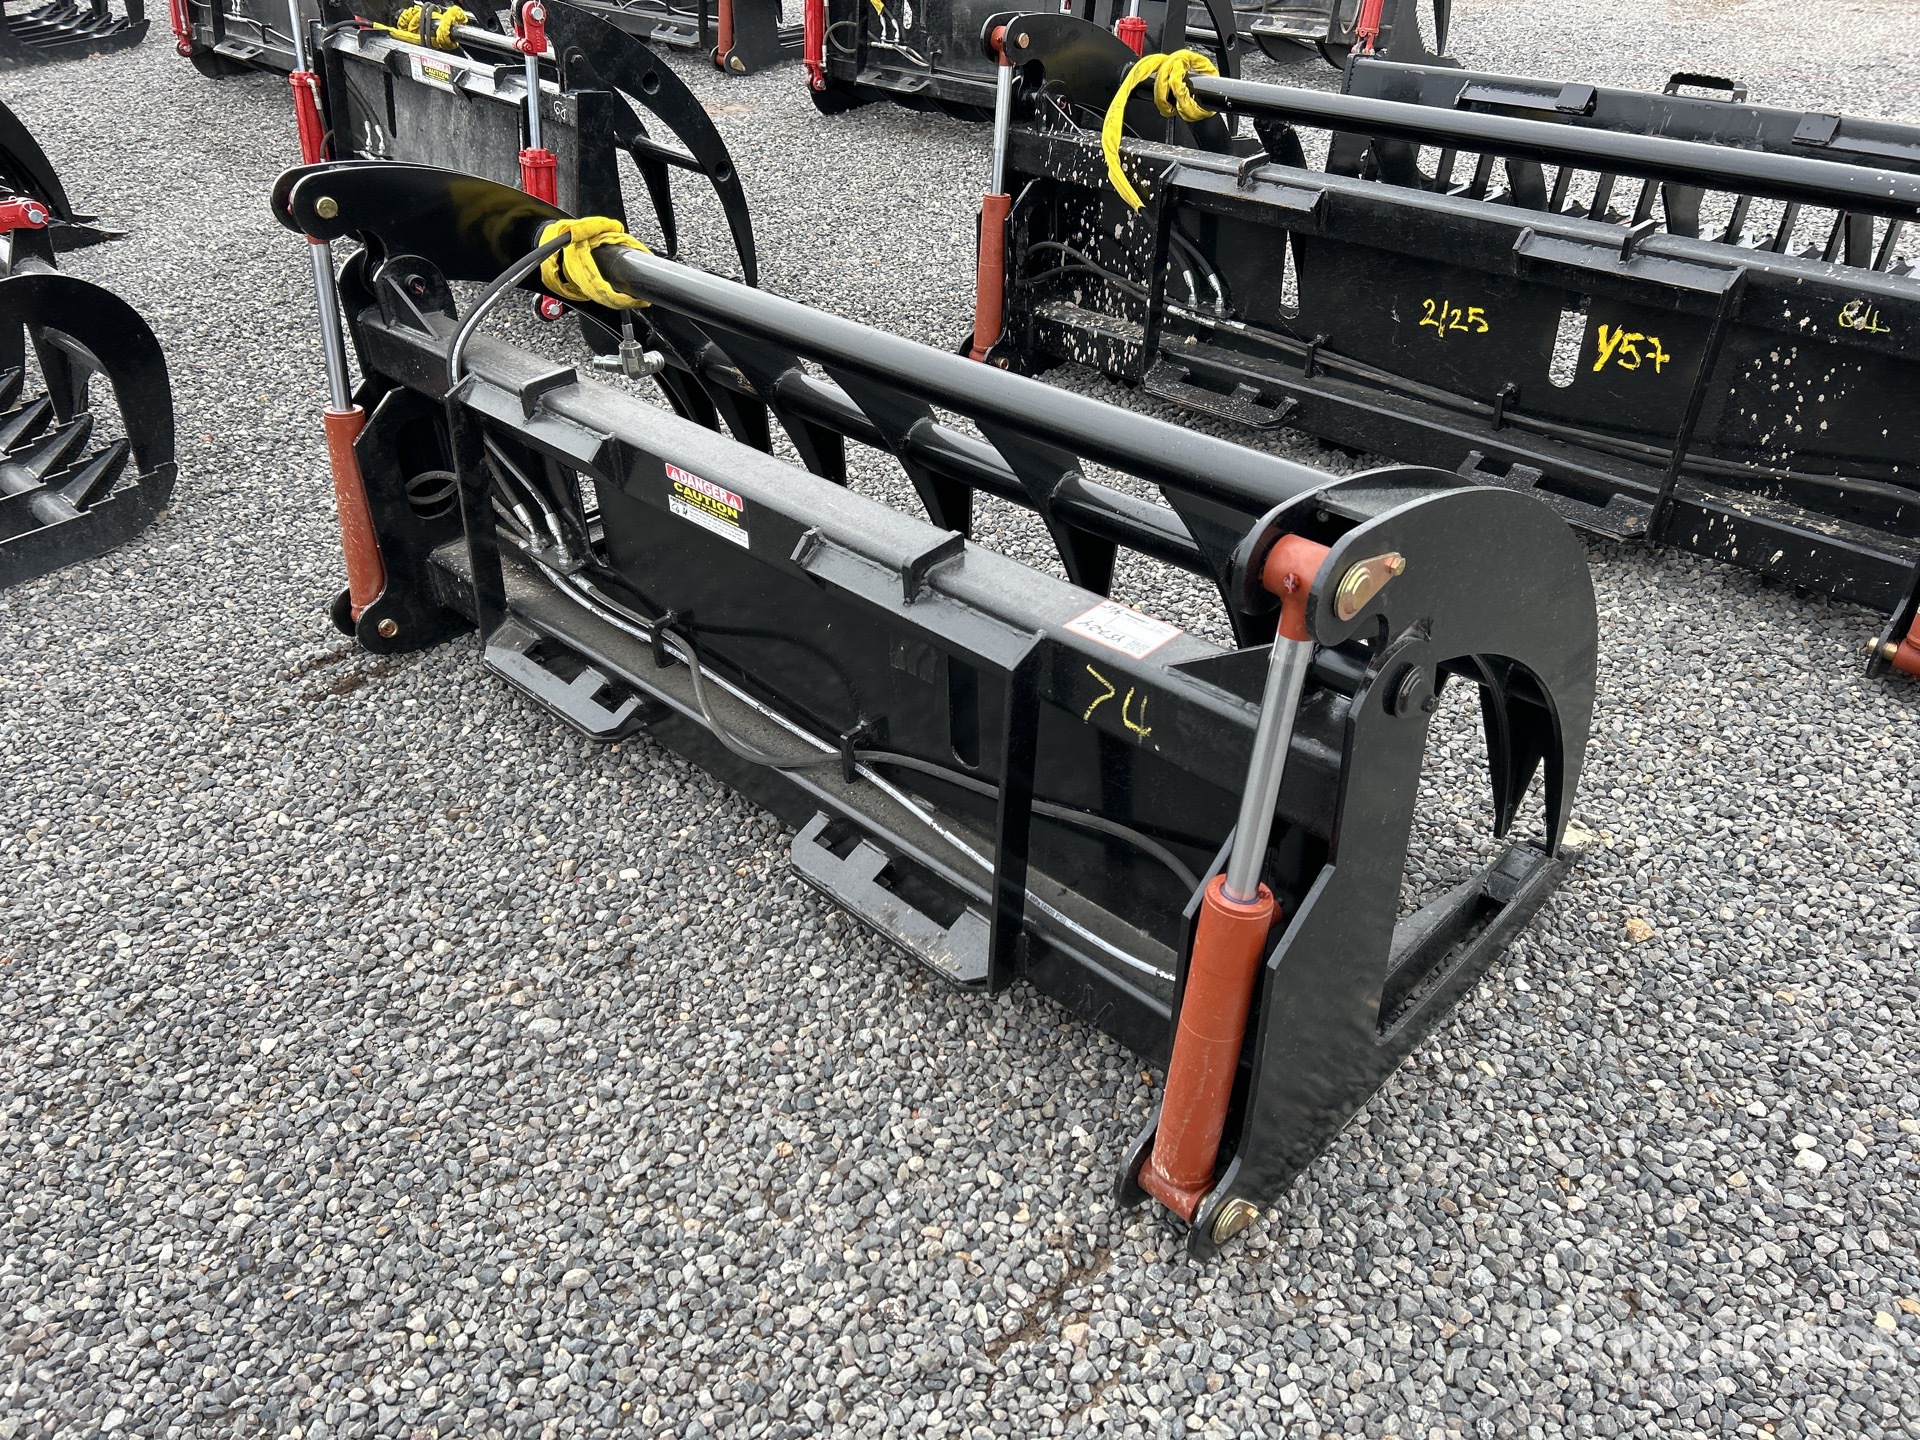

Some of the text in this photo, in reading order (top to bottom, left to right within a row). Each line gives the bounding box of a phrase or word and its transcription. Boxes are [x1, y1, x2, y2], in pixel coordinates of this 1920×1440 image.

[424, 66, 449, 80] CAUTION
[1419, 299, 1489, 338] 2/25
[1592, 323, 1671, 374] Y57
[673, 482, 738, 519] CAUTION
[680, 469, 729, 502] DANGER
[1083, 663, 1152, 745] 74
